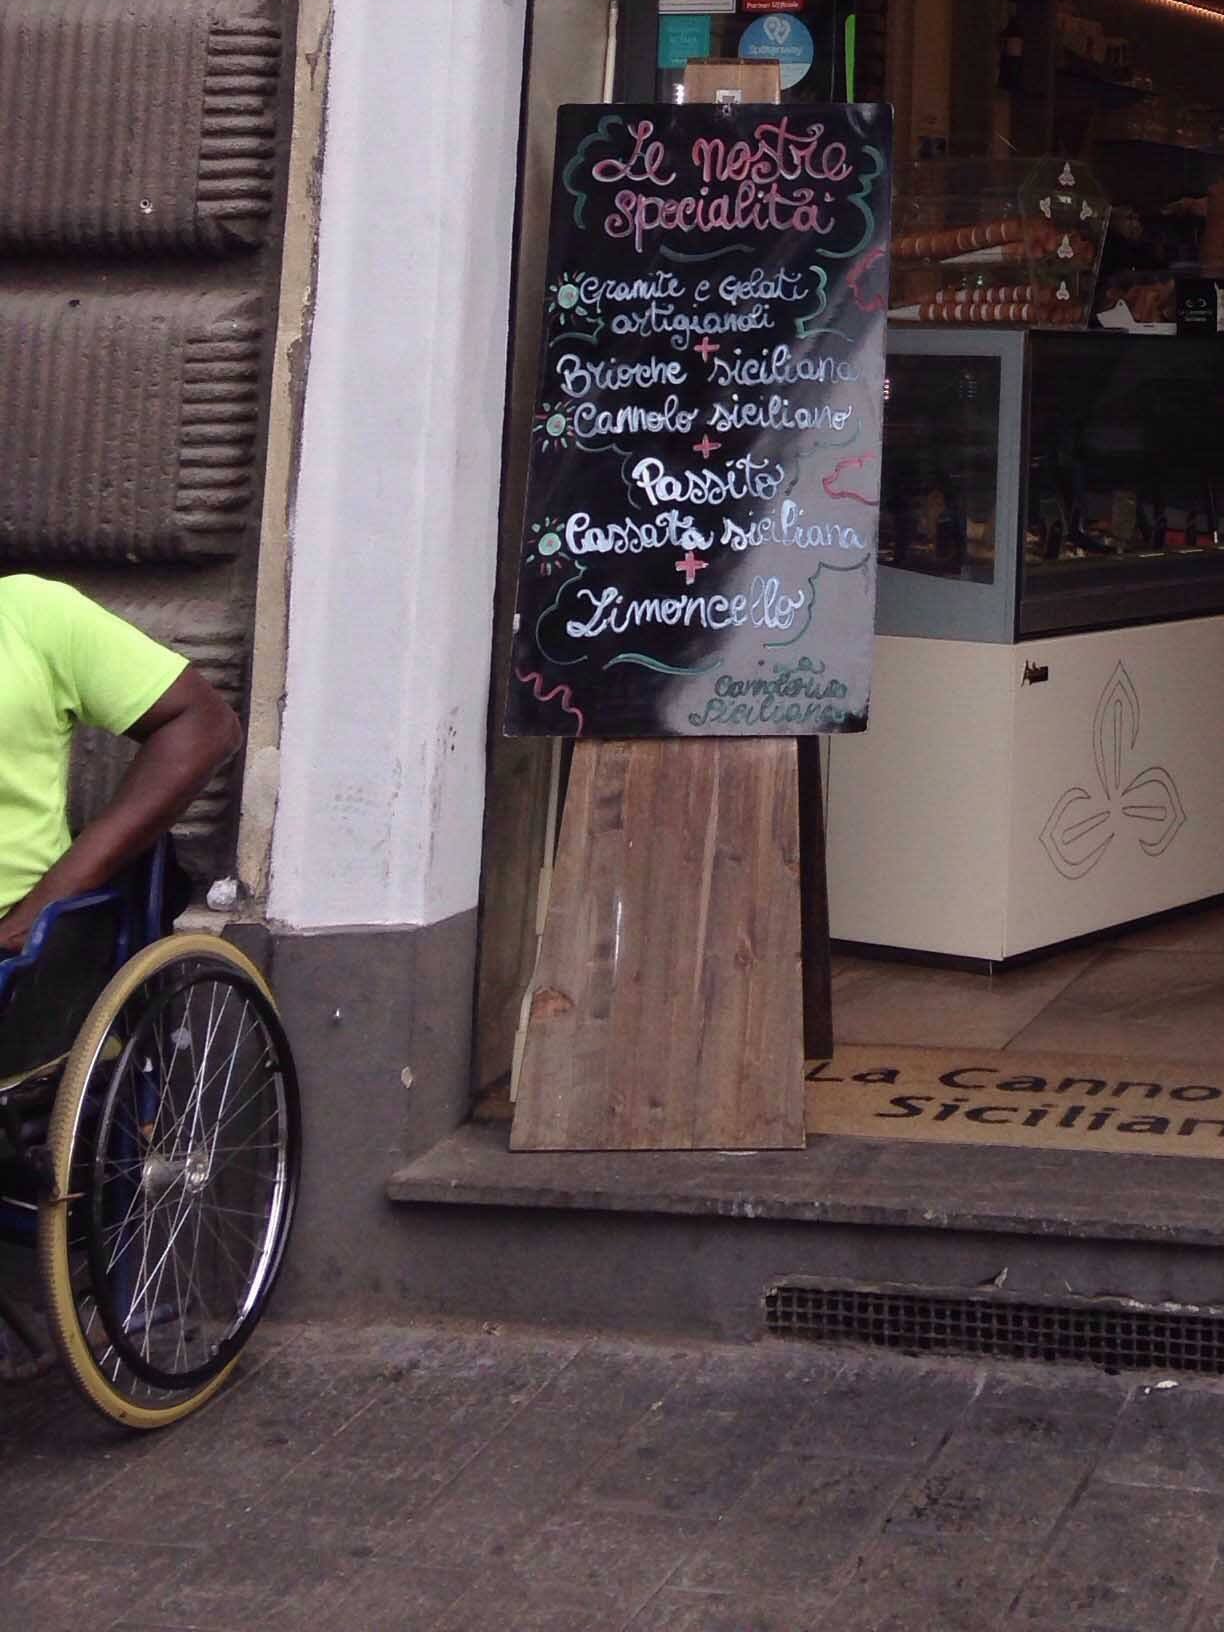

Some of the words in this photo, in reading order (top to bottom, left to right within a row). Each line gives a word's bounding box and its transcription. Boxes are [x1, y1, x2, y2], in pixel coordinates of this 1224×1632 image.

[591, 119, 677, 186] Le
[692, 116, 854, 186] nostre
[580, 270, 687, 313] Granite
[556, 353, 688, 398] Brioche
[573, 393, 701, 439] Cannolo
[705, 392, 852, 433] siciliano
[632, 453, 785, 507] Passito
[564, 508, 716, 555] Cassata
[719, 498, 867, 551] siciliana
[565, 575, 807, 638] Limoncello
[803, 1061, 901, 1085] La
